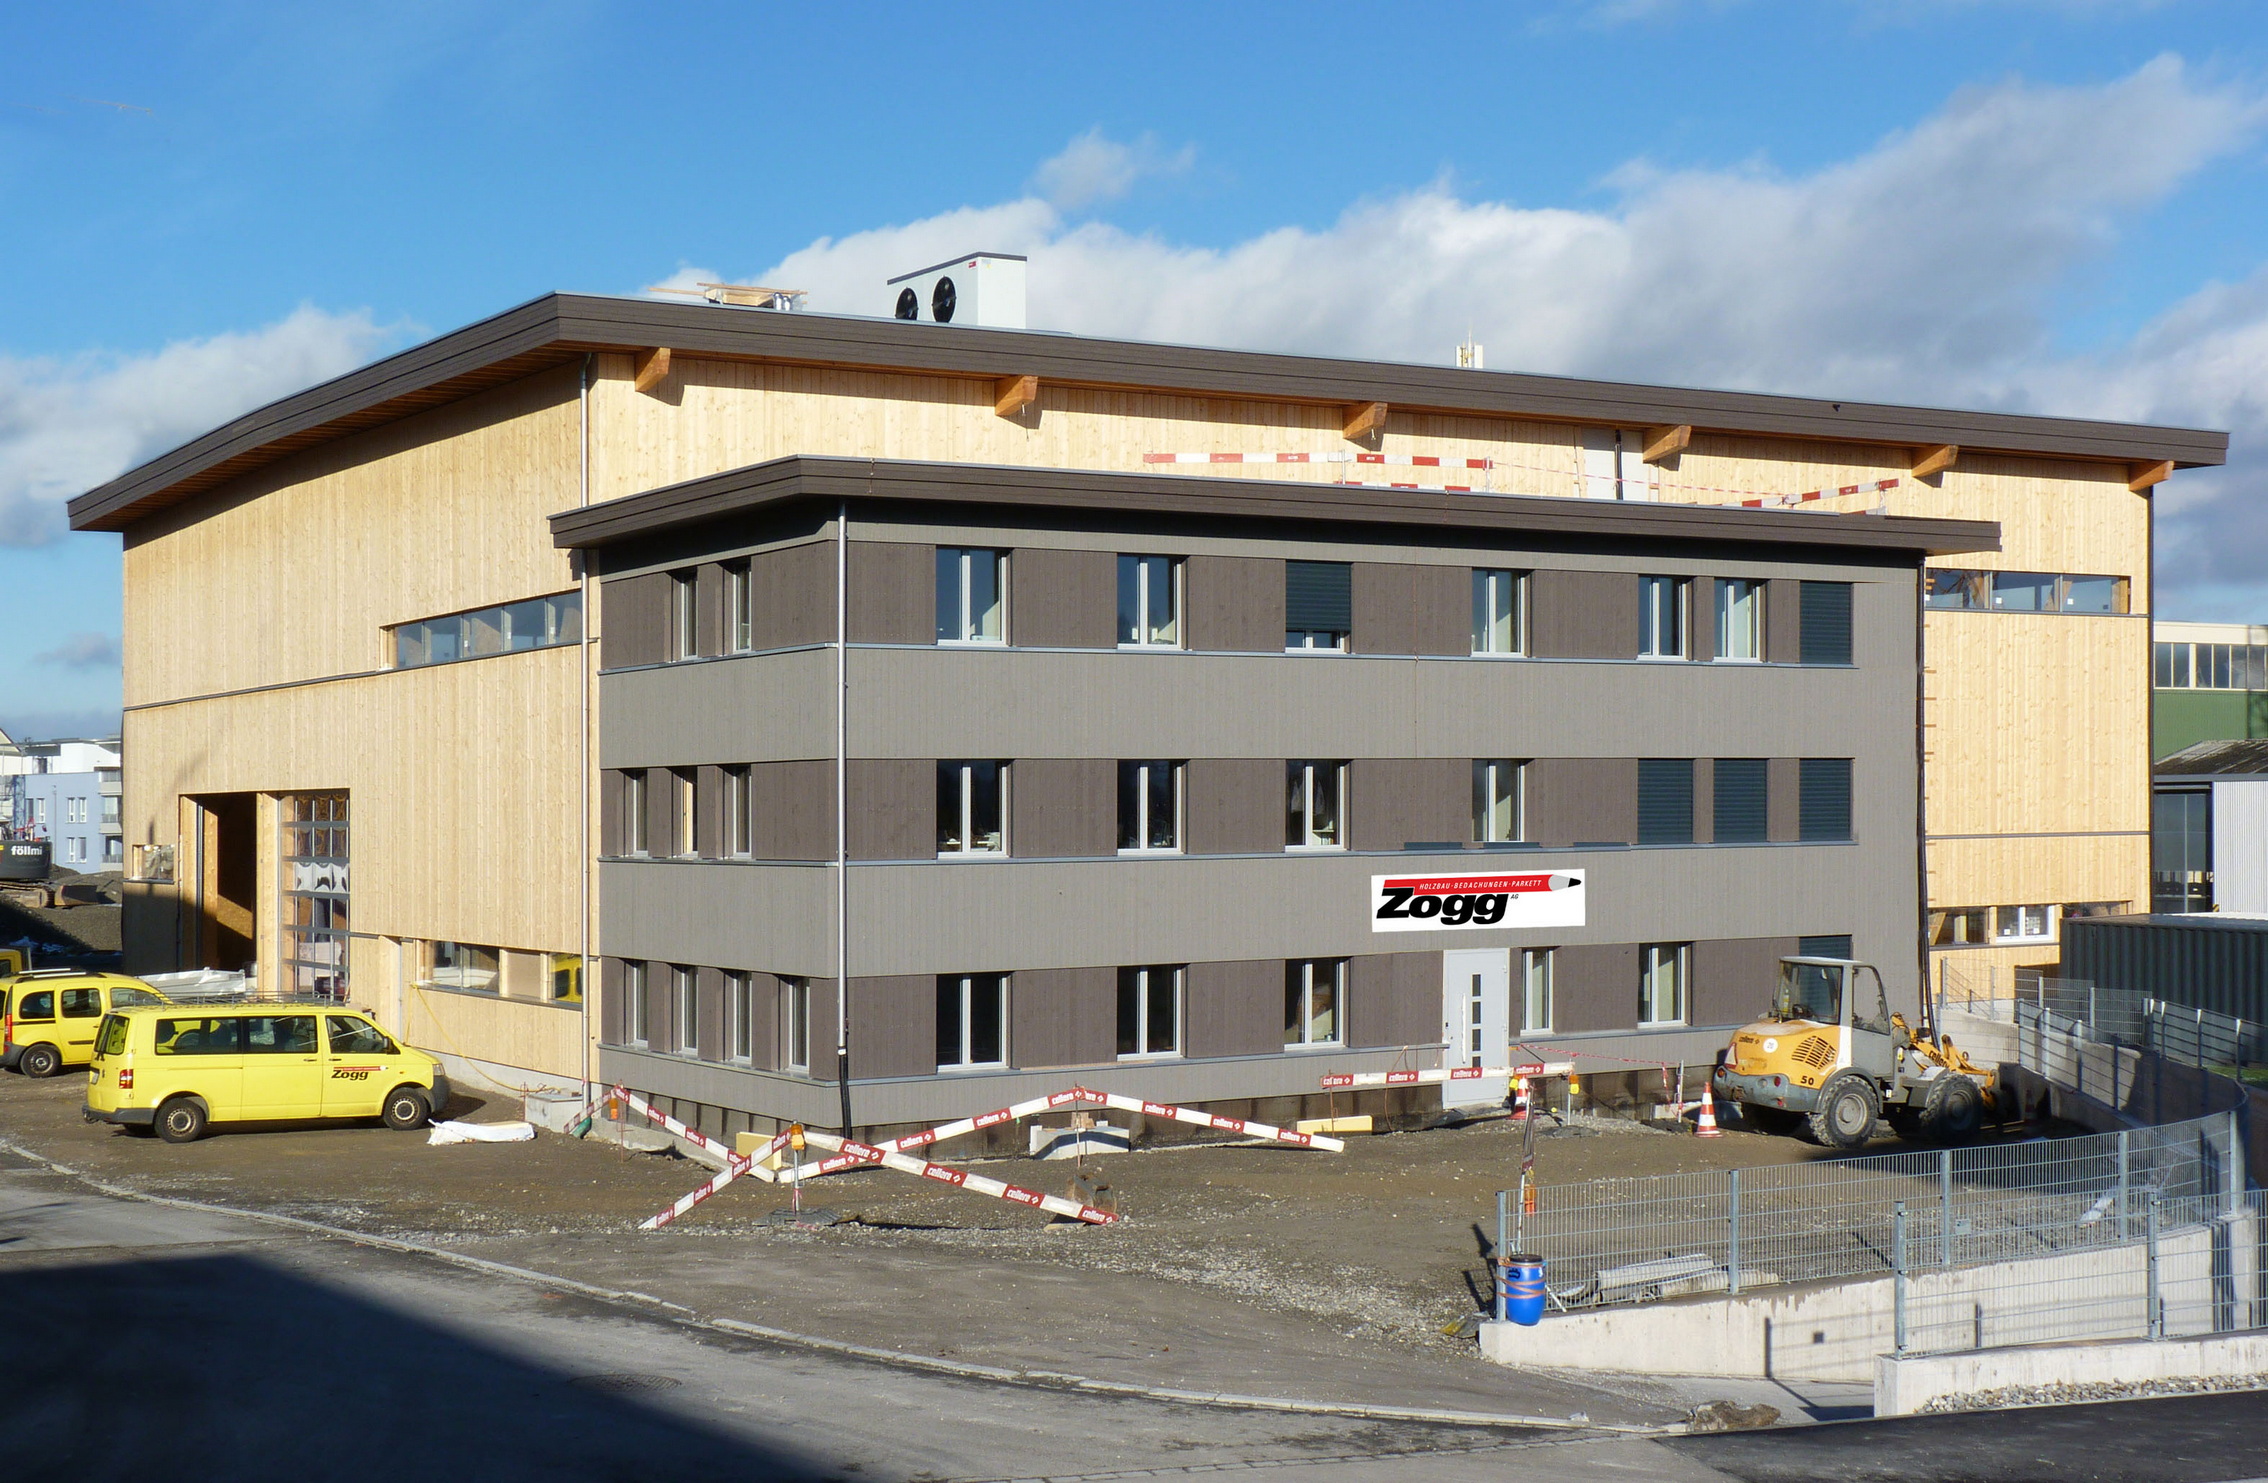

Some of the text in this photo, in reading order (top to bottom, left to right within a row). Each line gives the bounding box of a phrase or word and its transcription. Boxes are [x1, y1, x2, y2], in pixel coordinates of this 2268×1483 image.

[11, 846, 43, 856] föllmi
[1453, 881, 1508, 889] BEDACHUNGEN
[1376, 887, 1509, 925] Zogg
[331, 1069, 369, 1081] Zogg
[1800, 1075, 1815, 1086] 50
